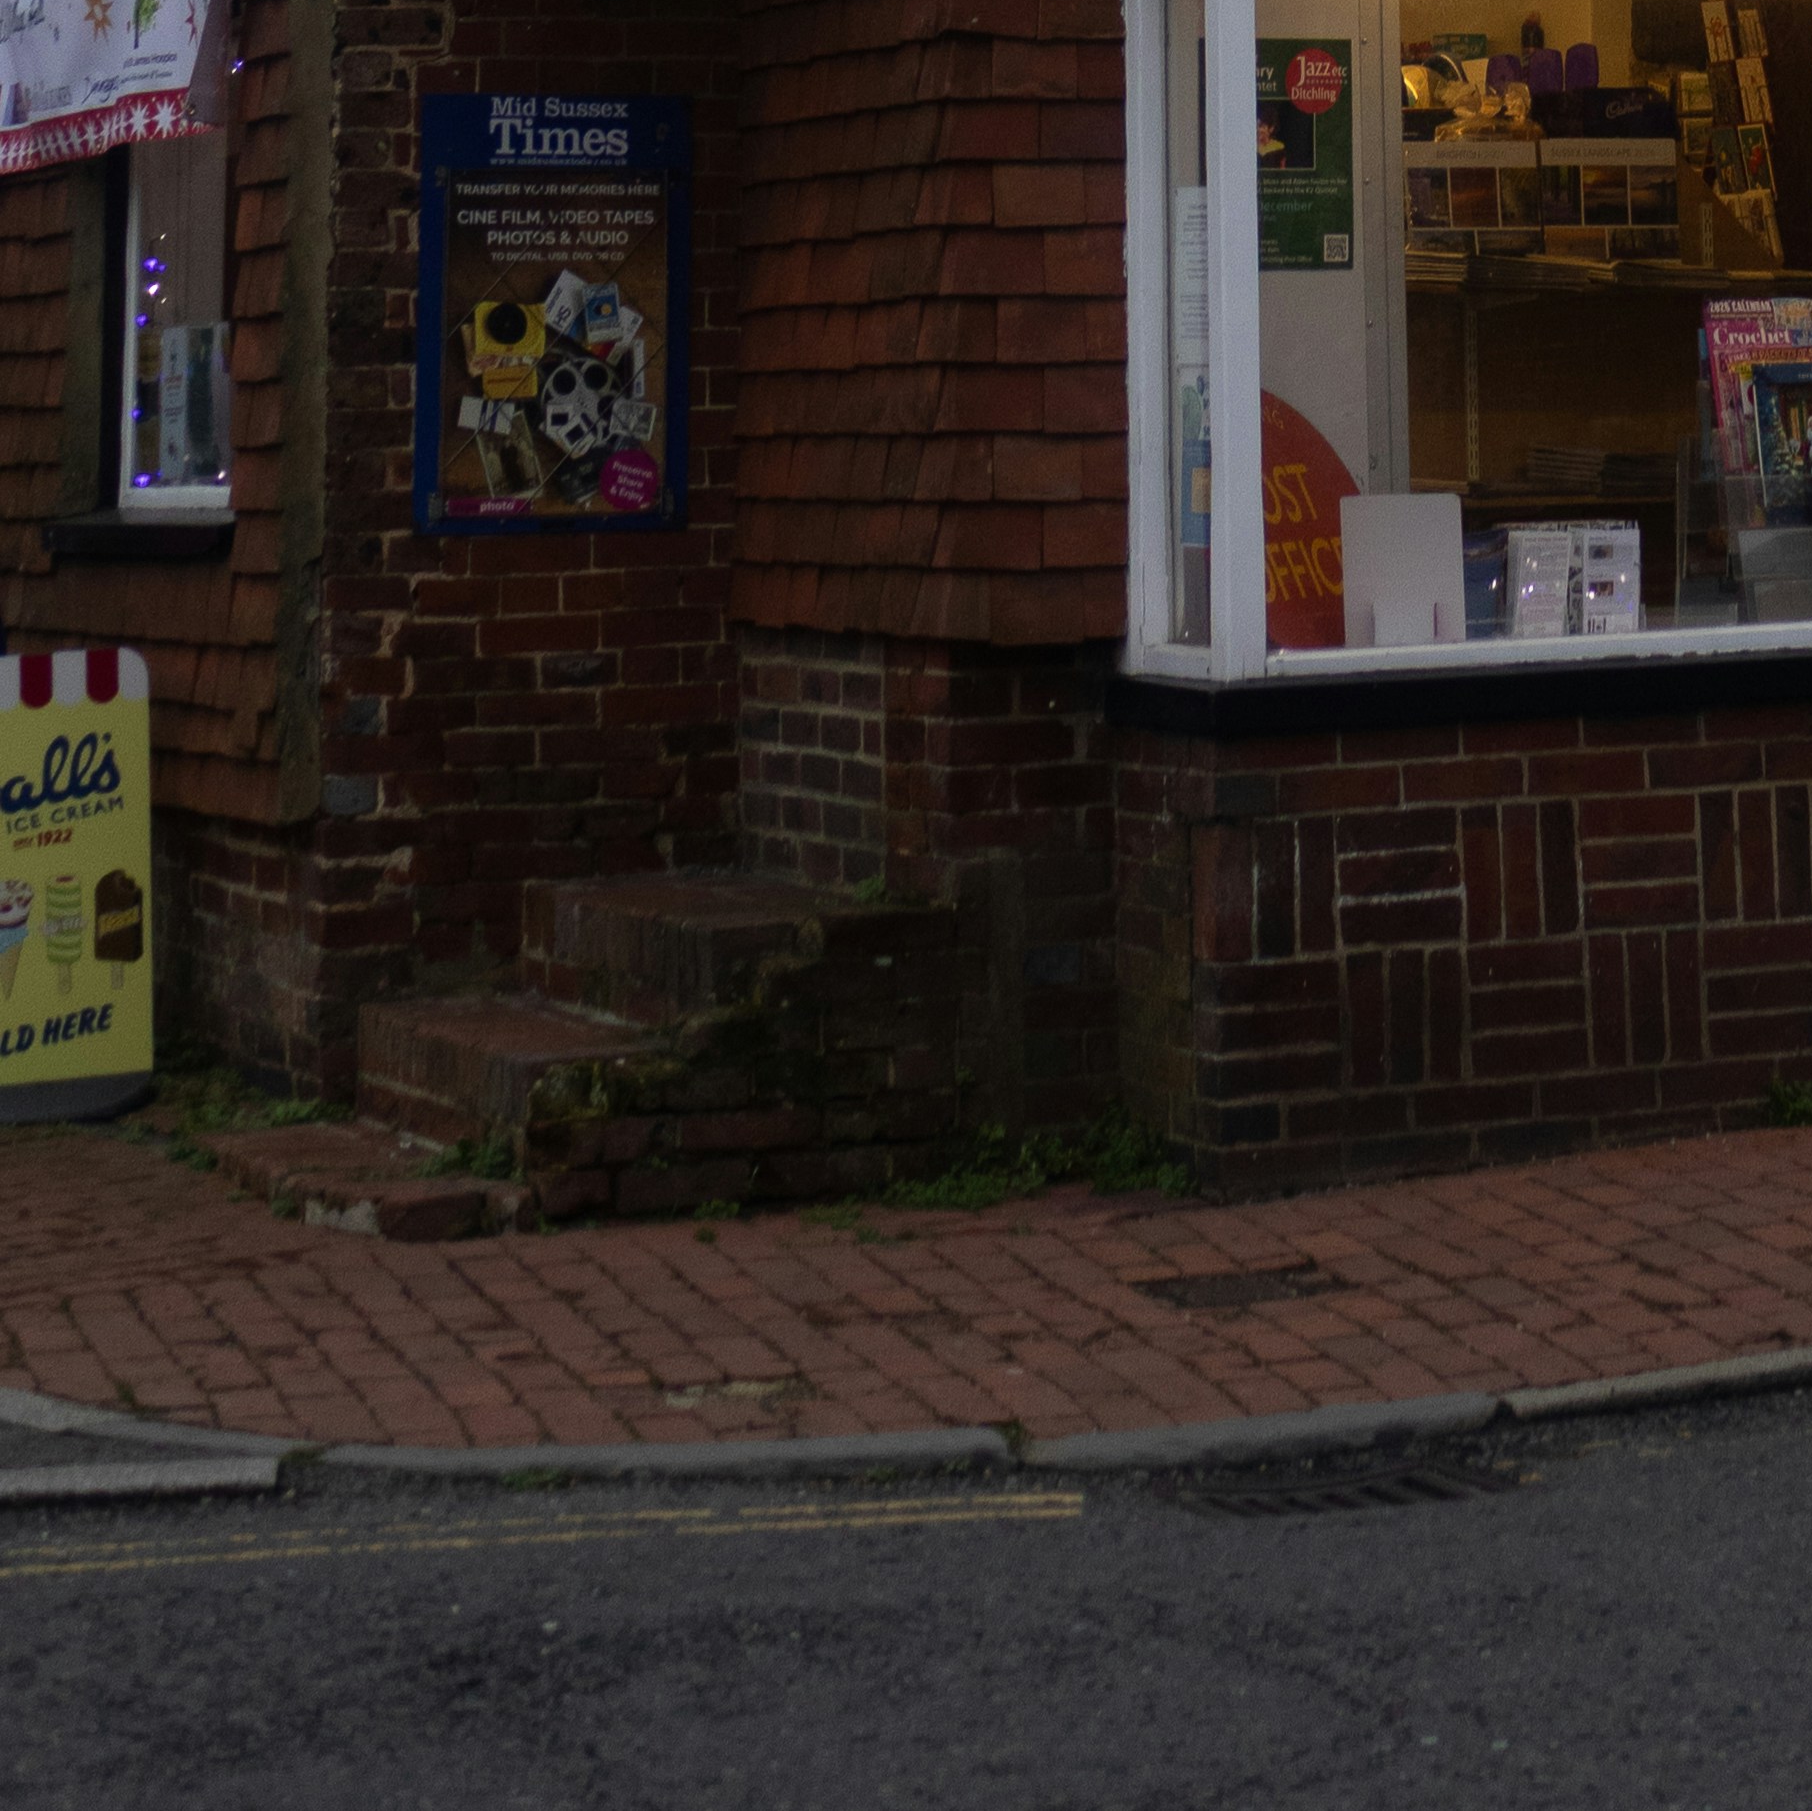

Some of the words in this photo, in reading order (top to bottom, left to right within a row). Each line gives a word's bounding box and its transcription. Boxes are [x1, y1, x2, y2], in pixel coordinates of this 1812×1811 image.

[1296, 55, 1331, 87] Jazz
[1331, 65, 1348, 77] etc
[1291, 86, 1337, 102] Ditchling
[490, 96, 537, 118] Mid
[544, 97, 629, 119] Sussex
[489, 118, 629, 157] Times
[456, 184, 520, 196] TRANSFER
[560, 184, 625, 196] MEMORIES
[628, 183, 661, 196] HERE
[1260, 200, 1314, 212] ecember
[456, 210, 497, 225] CINE
[547, 209, 600, 225] VIDEO
[487, 230, 556, 246] PHOTOS
[560, 230, 571, 246] &
[576, 230, 629, 246] AUDIO
[490, 252, 504, 262] TO
[1713, 326, 1792, 346] Crochet
[1262, 463, 1318, 525] OST
[0, 732, 120, 814] all's
[6, 817, 42, 835] ICE
[51, 796, 125, 824] CREAM
[37, 828, 73, 848] 1922
[0, 1024, 35, 1056] LD
[43, 1003, 114, 1046] HERE
